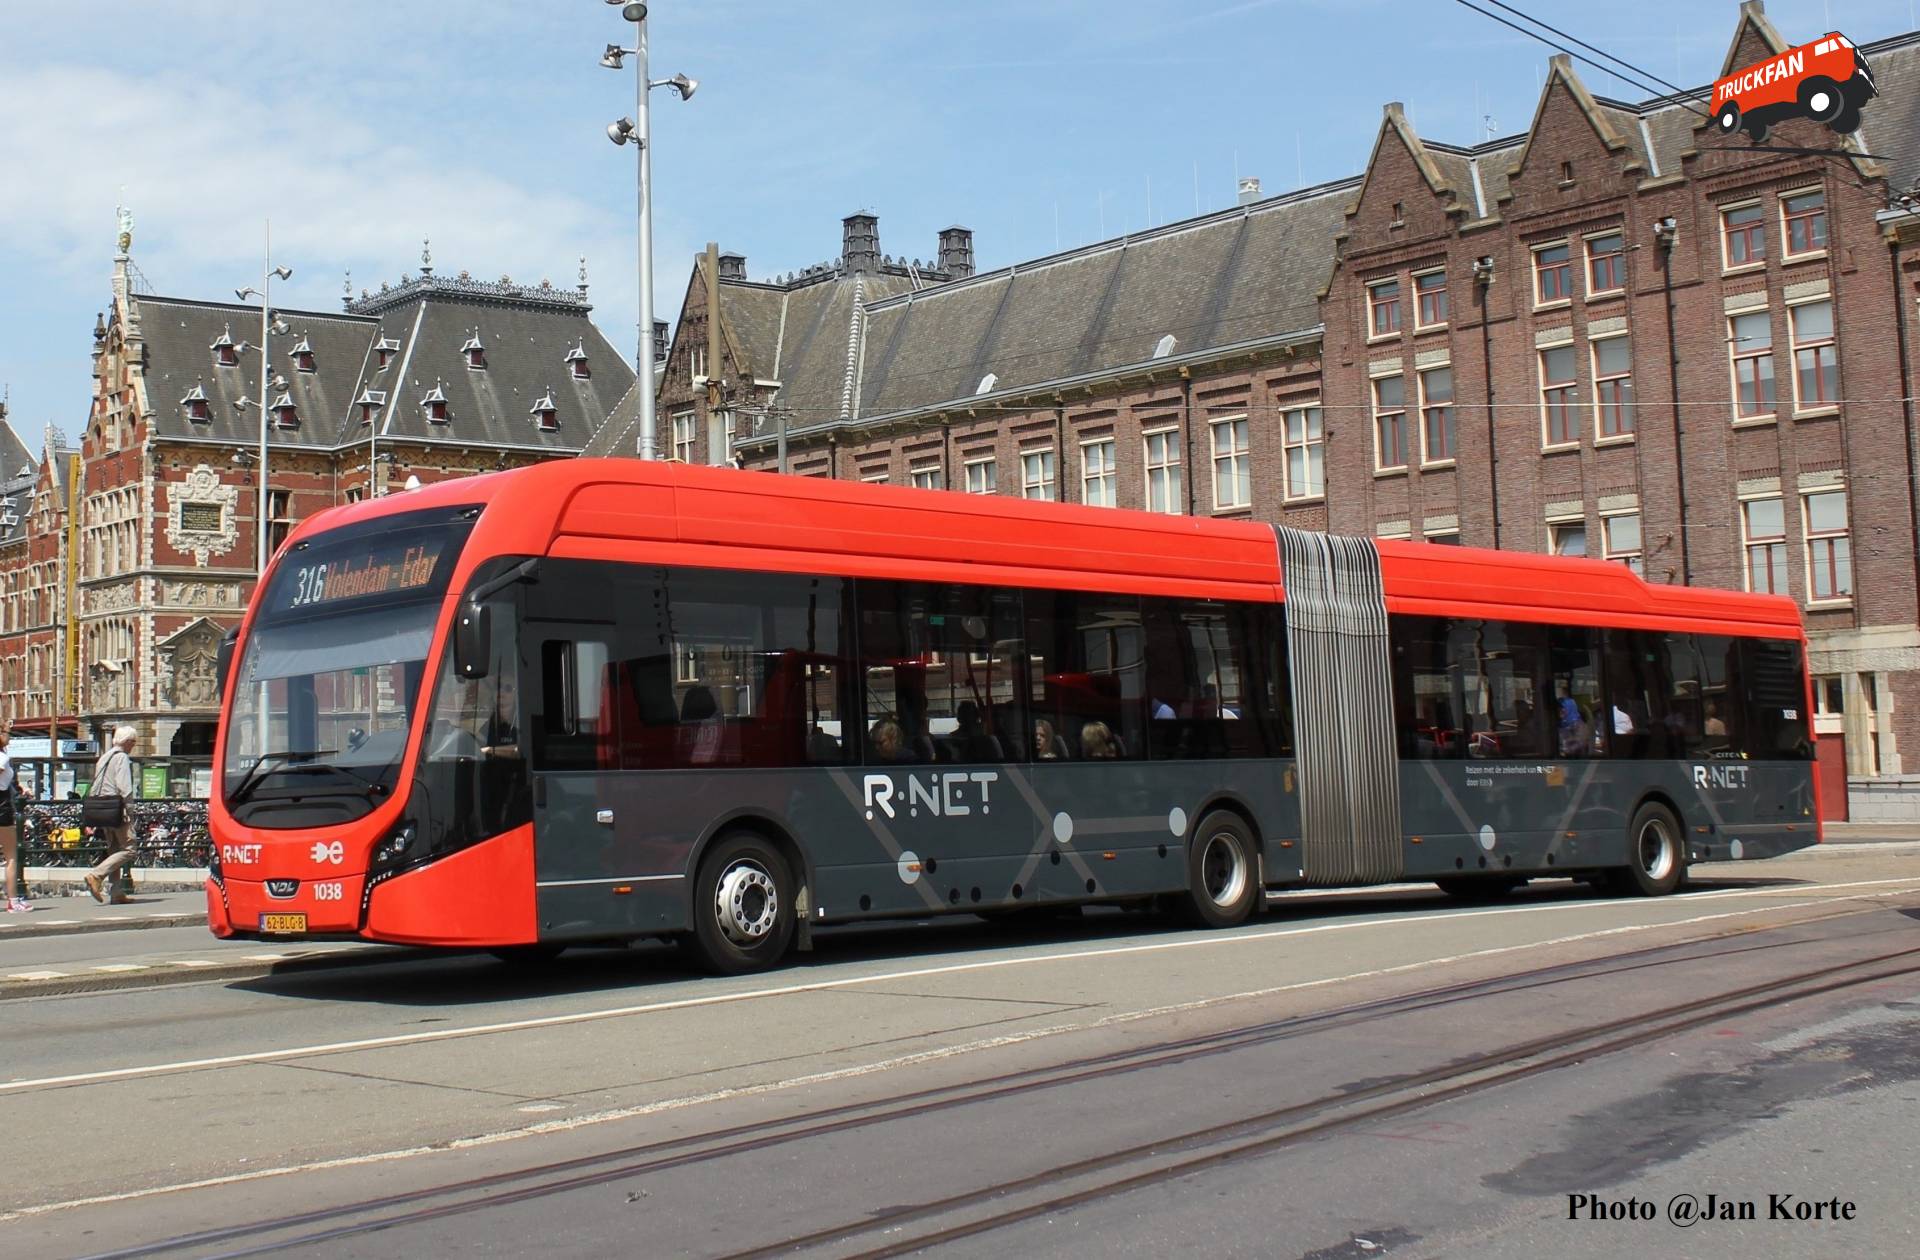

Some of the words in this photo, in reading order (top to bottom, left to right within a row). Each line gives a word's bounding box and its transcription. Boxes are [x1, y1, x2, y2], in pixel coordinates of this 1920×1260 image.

[294, 564, 327, 605] 316
[324, 556, 391, 600] Volendam
[271, 881, 295, 892] VDL
[313, 883, 342, 900] 1038
[266, 916, 304, 930] 62-BLG-8
